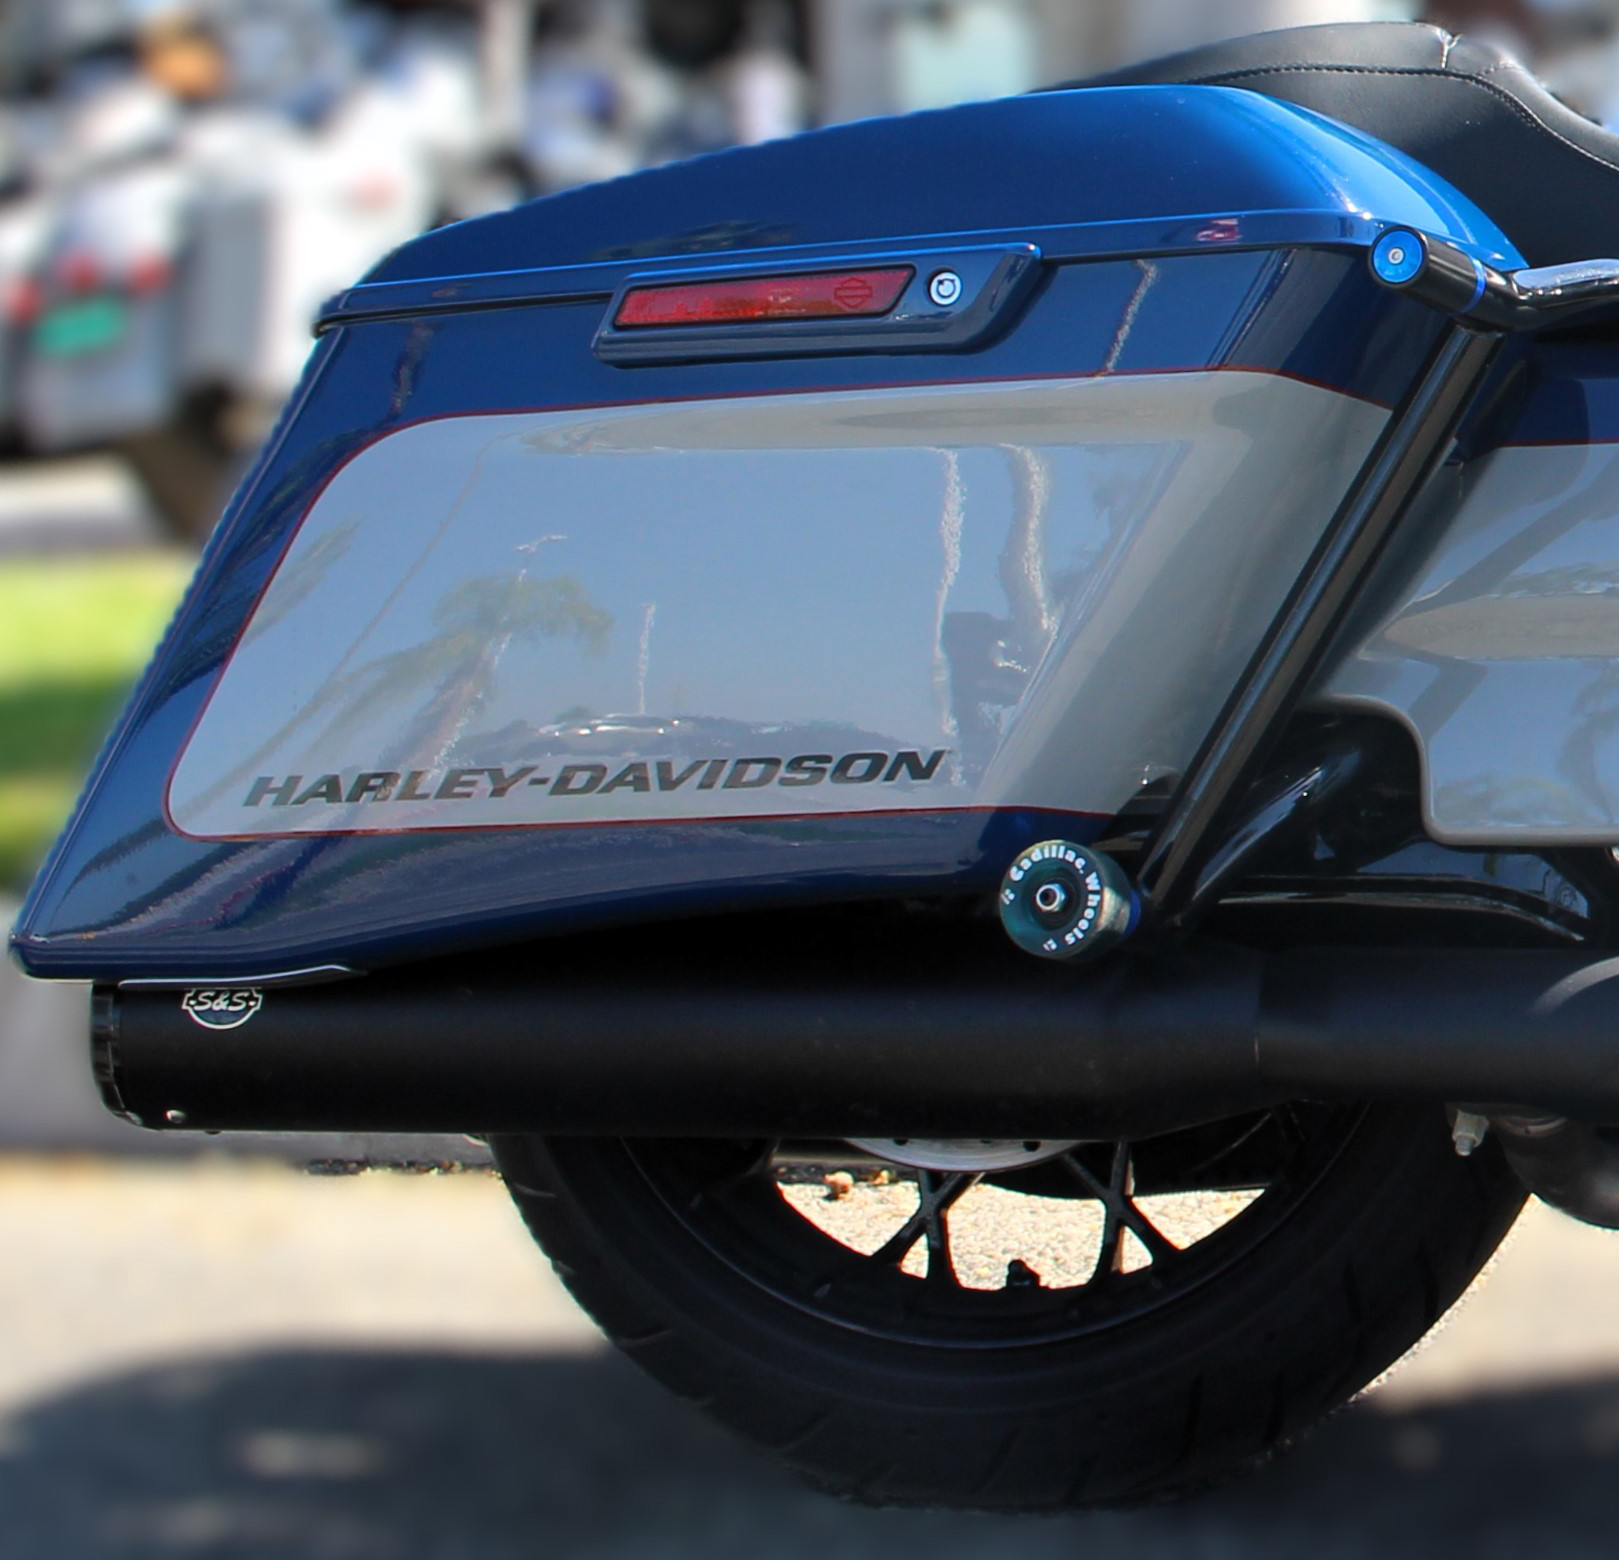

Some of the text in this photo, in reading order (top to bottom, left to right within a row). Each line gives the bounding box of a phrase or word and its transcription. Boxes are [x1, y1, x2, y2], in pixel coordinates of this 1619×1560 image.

[242, 749, 949, 807] HARLEY-DAVIDSON
[1064, 871, 1101, 945] Wheels
[194, 991, 248, 1011] S&S
